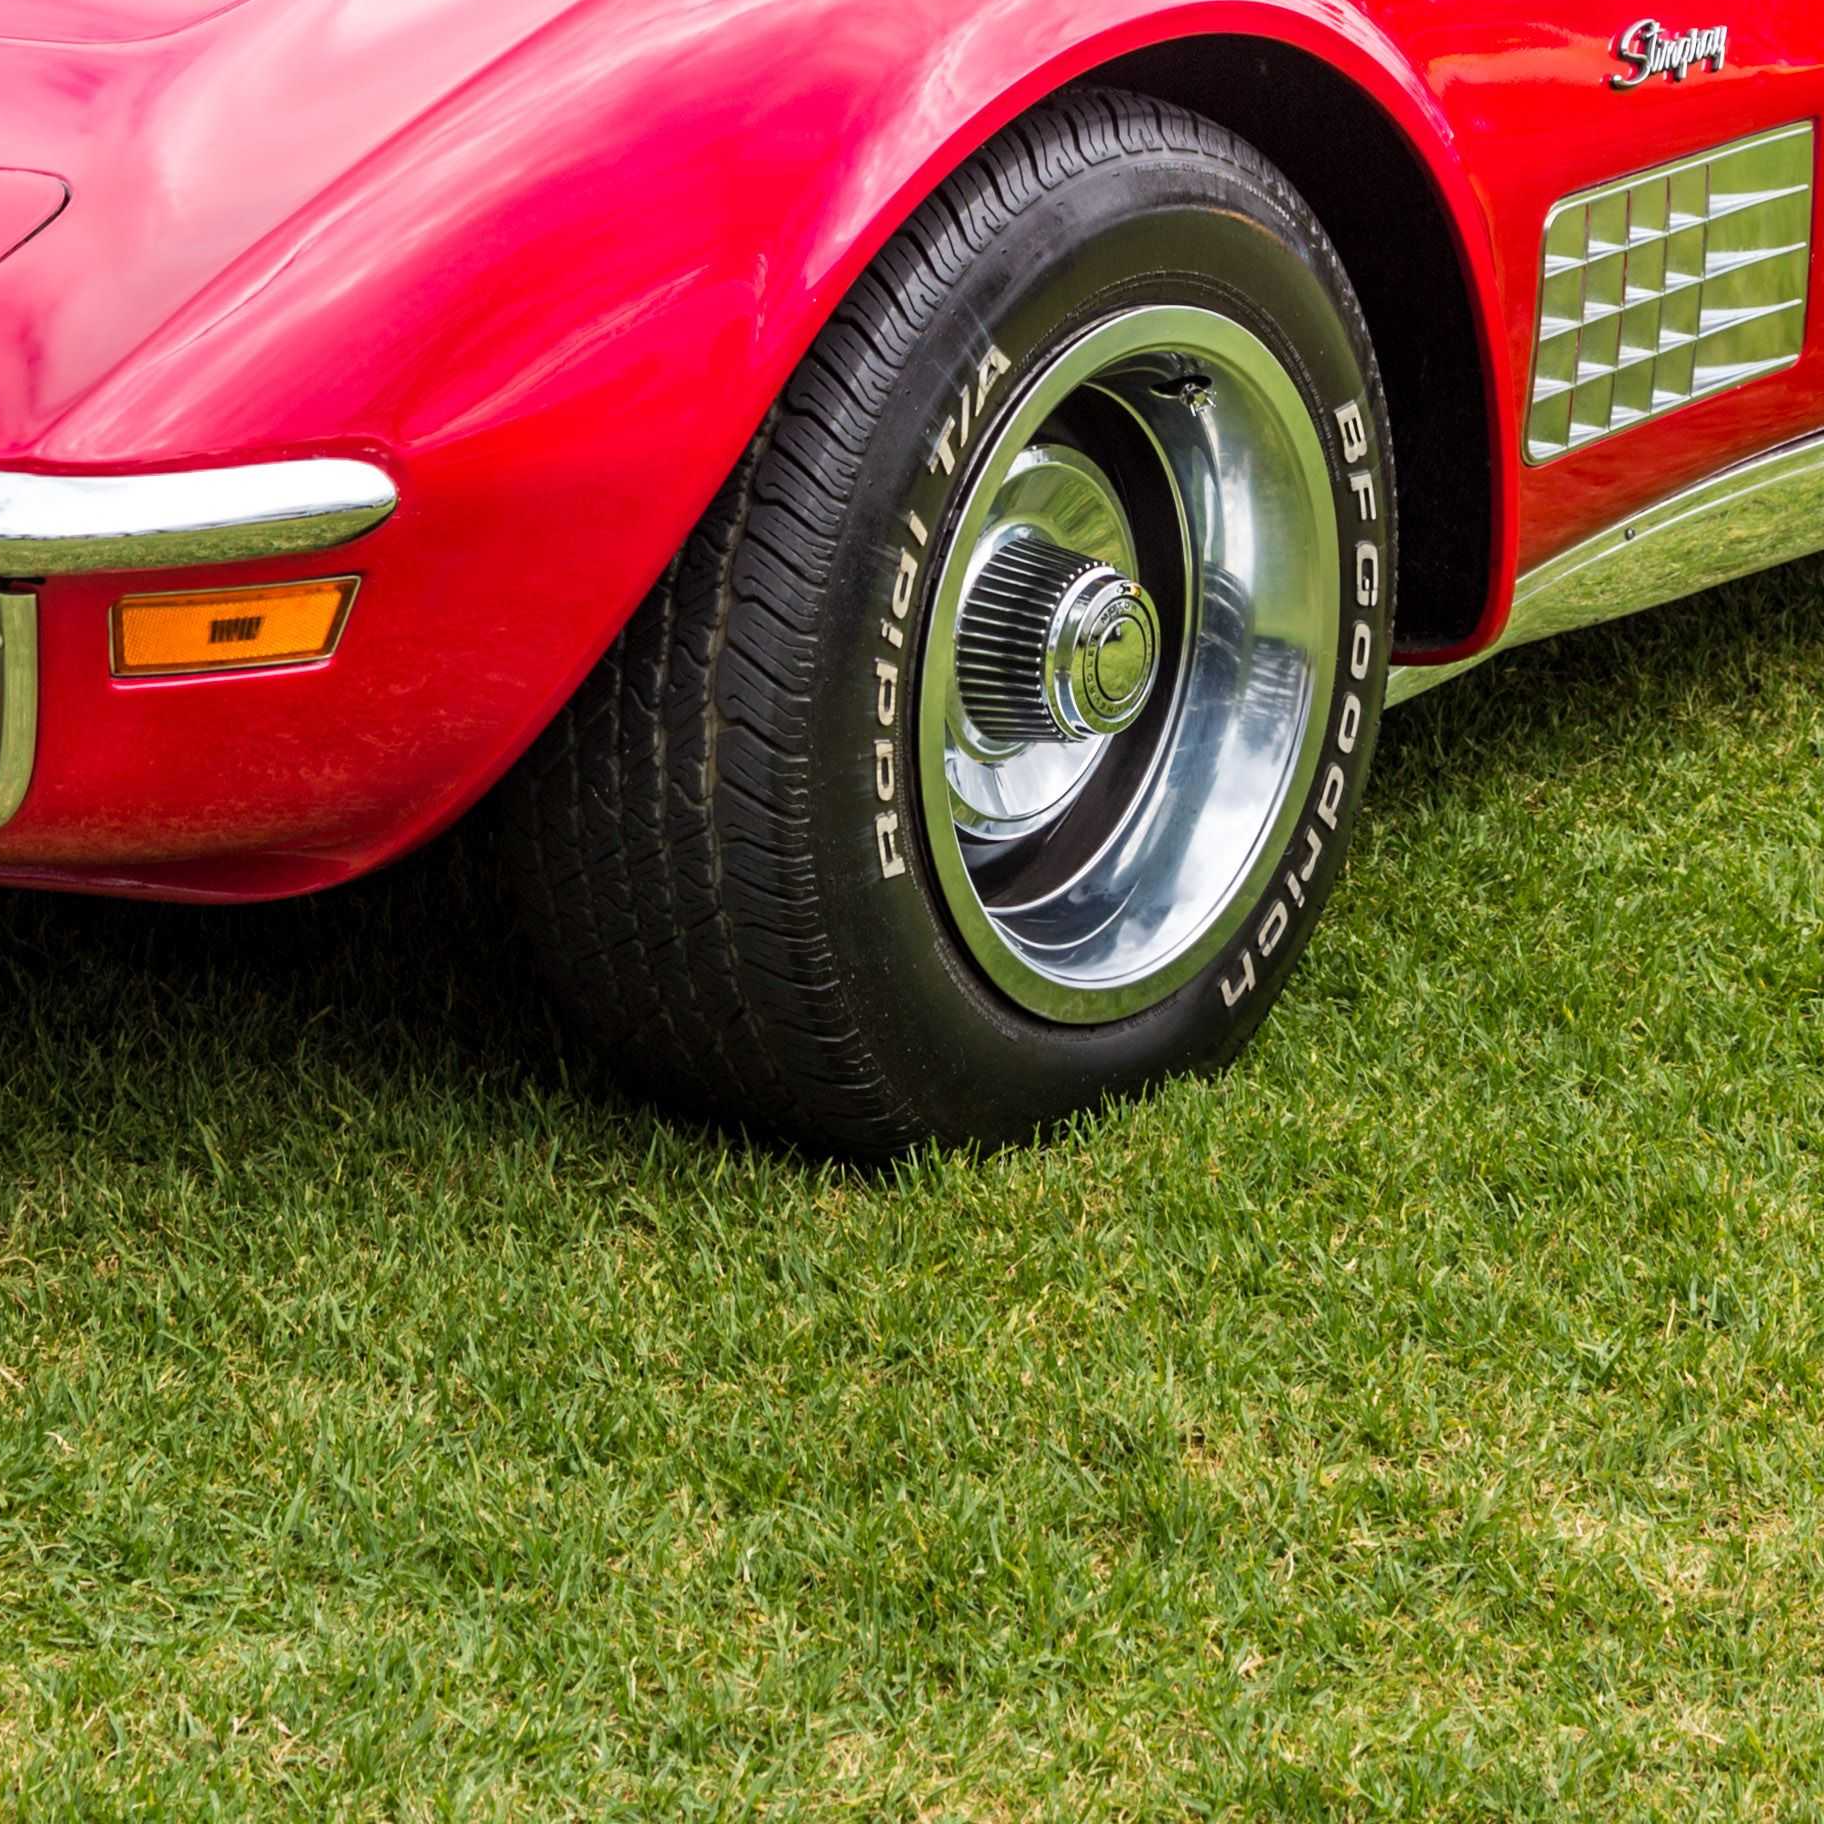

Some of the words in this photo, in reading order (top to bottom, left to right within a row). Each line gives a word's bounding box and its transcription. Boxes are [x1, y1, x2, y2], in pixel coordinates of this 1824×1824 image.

[1612, 18, 1728, 87] Stingray
[874, 510, 930, 880] Radial
[928, 344, 1012, 478] T/A
[1218, 400, 1381, 1010] BFGoodrich
